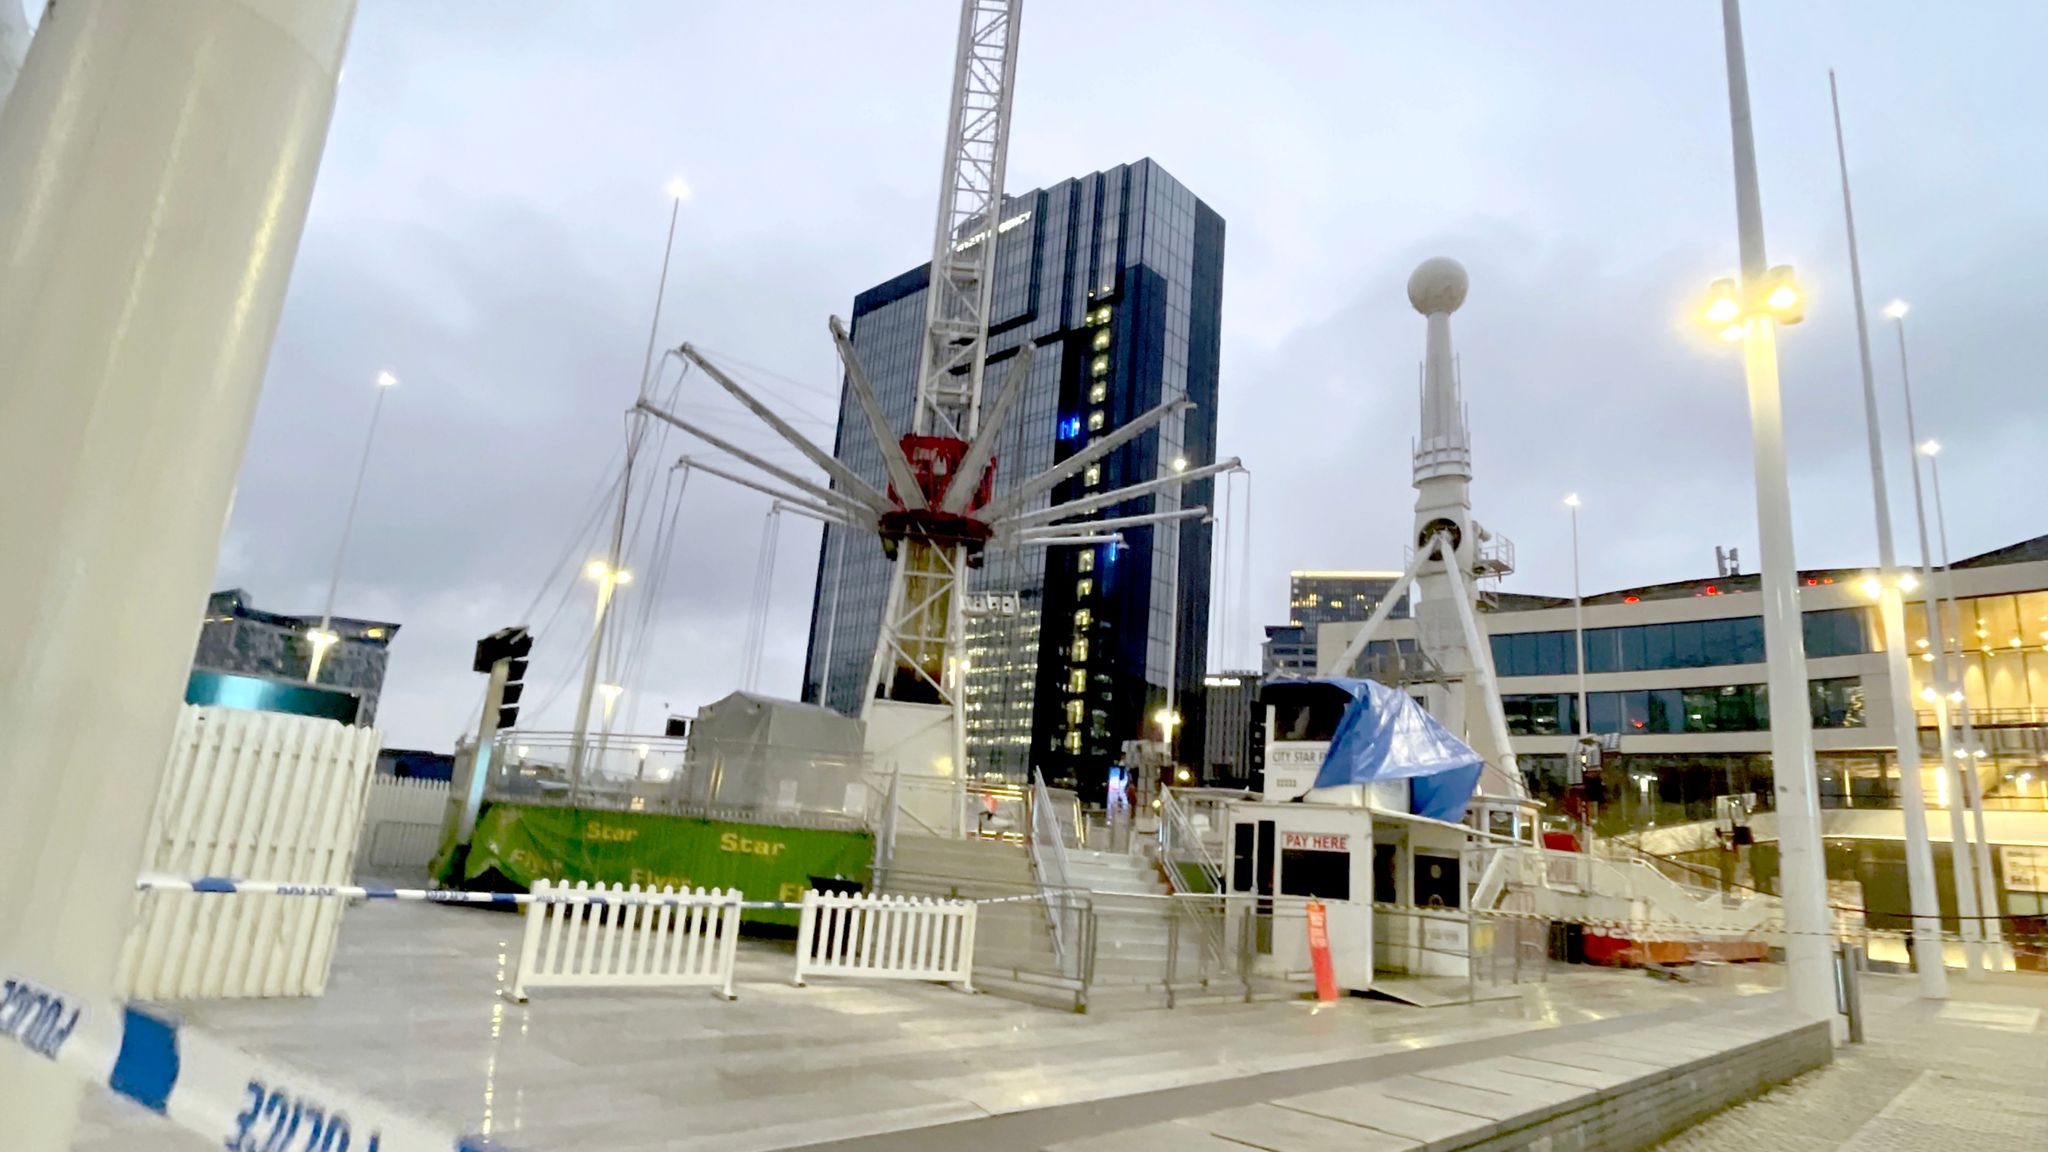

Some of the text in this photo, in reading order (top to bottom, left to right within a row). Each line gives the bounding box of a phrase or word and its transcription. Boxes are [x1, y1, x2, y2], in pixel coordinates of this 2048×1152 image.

[1272, 751, 1292, 762] CITY
[1294, 751, 1316, 762] STAR
[586, 820, 639, 842] Star
[1286, 832, 1347, 850] PAY HERE
[720, 832, 786, 856] Star
